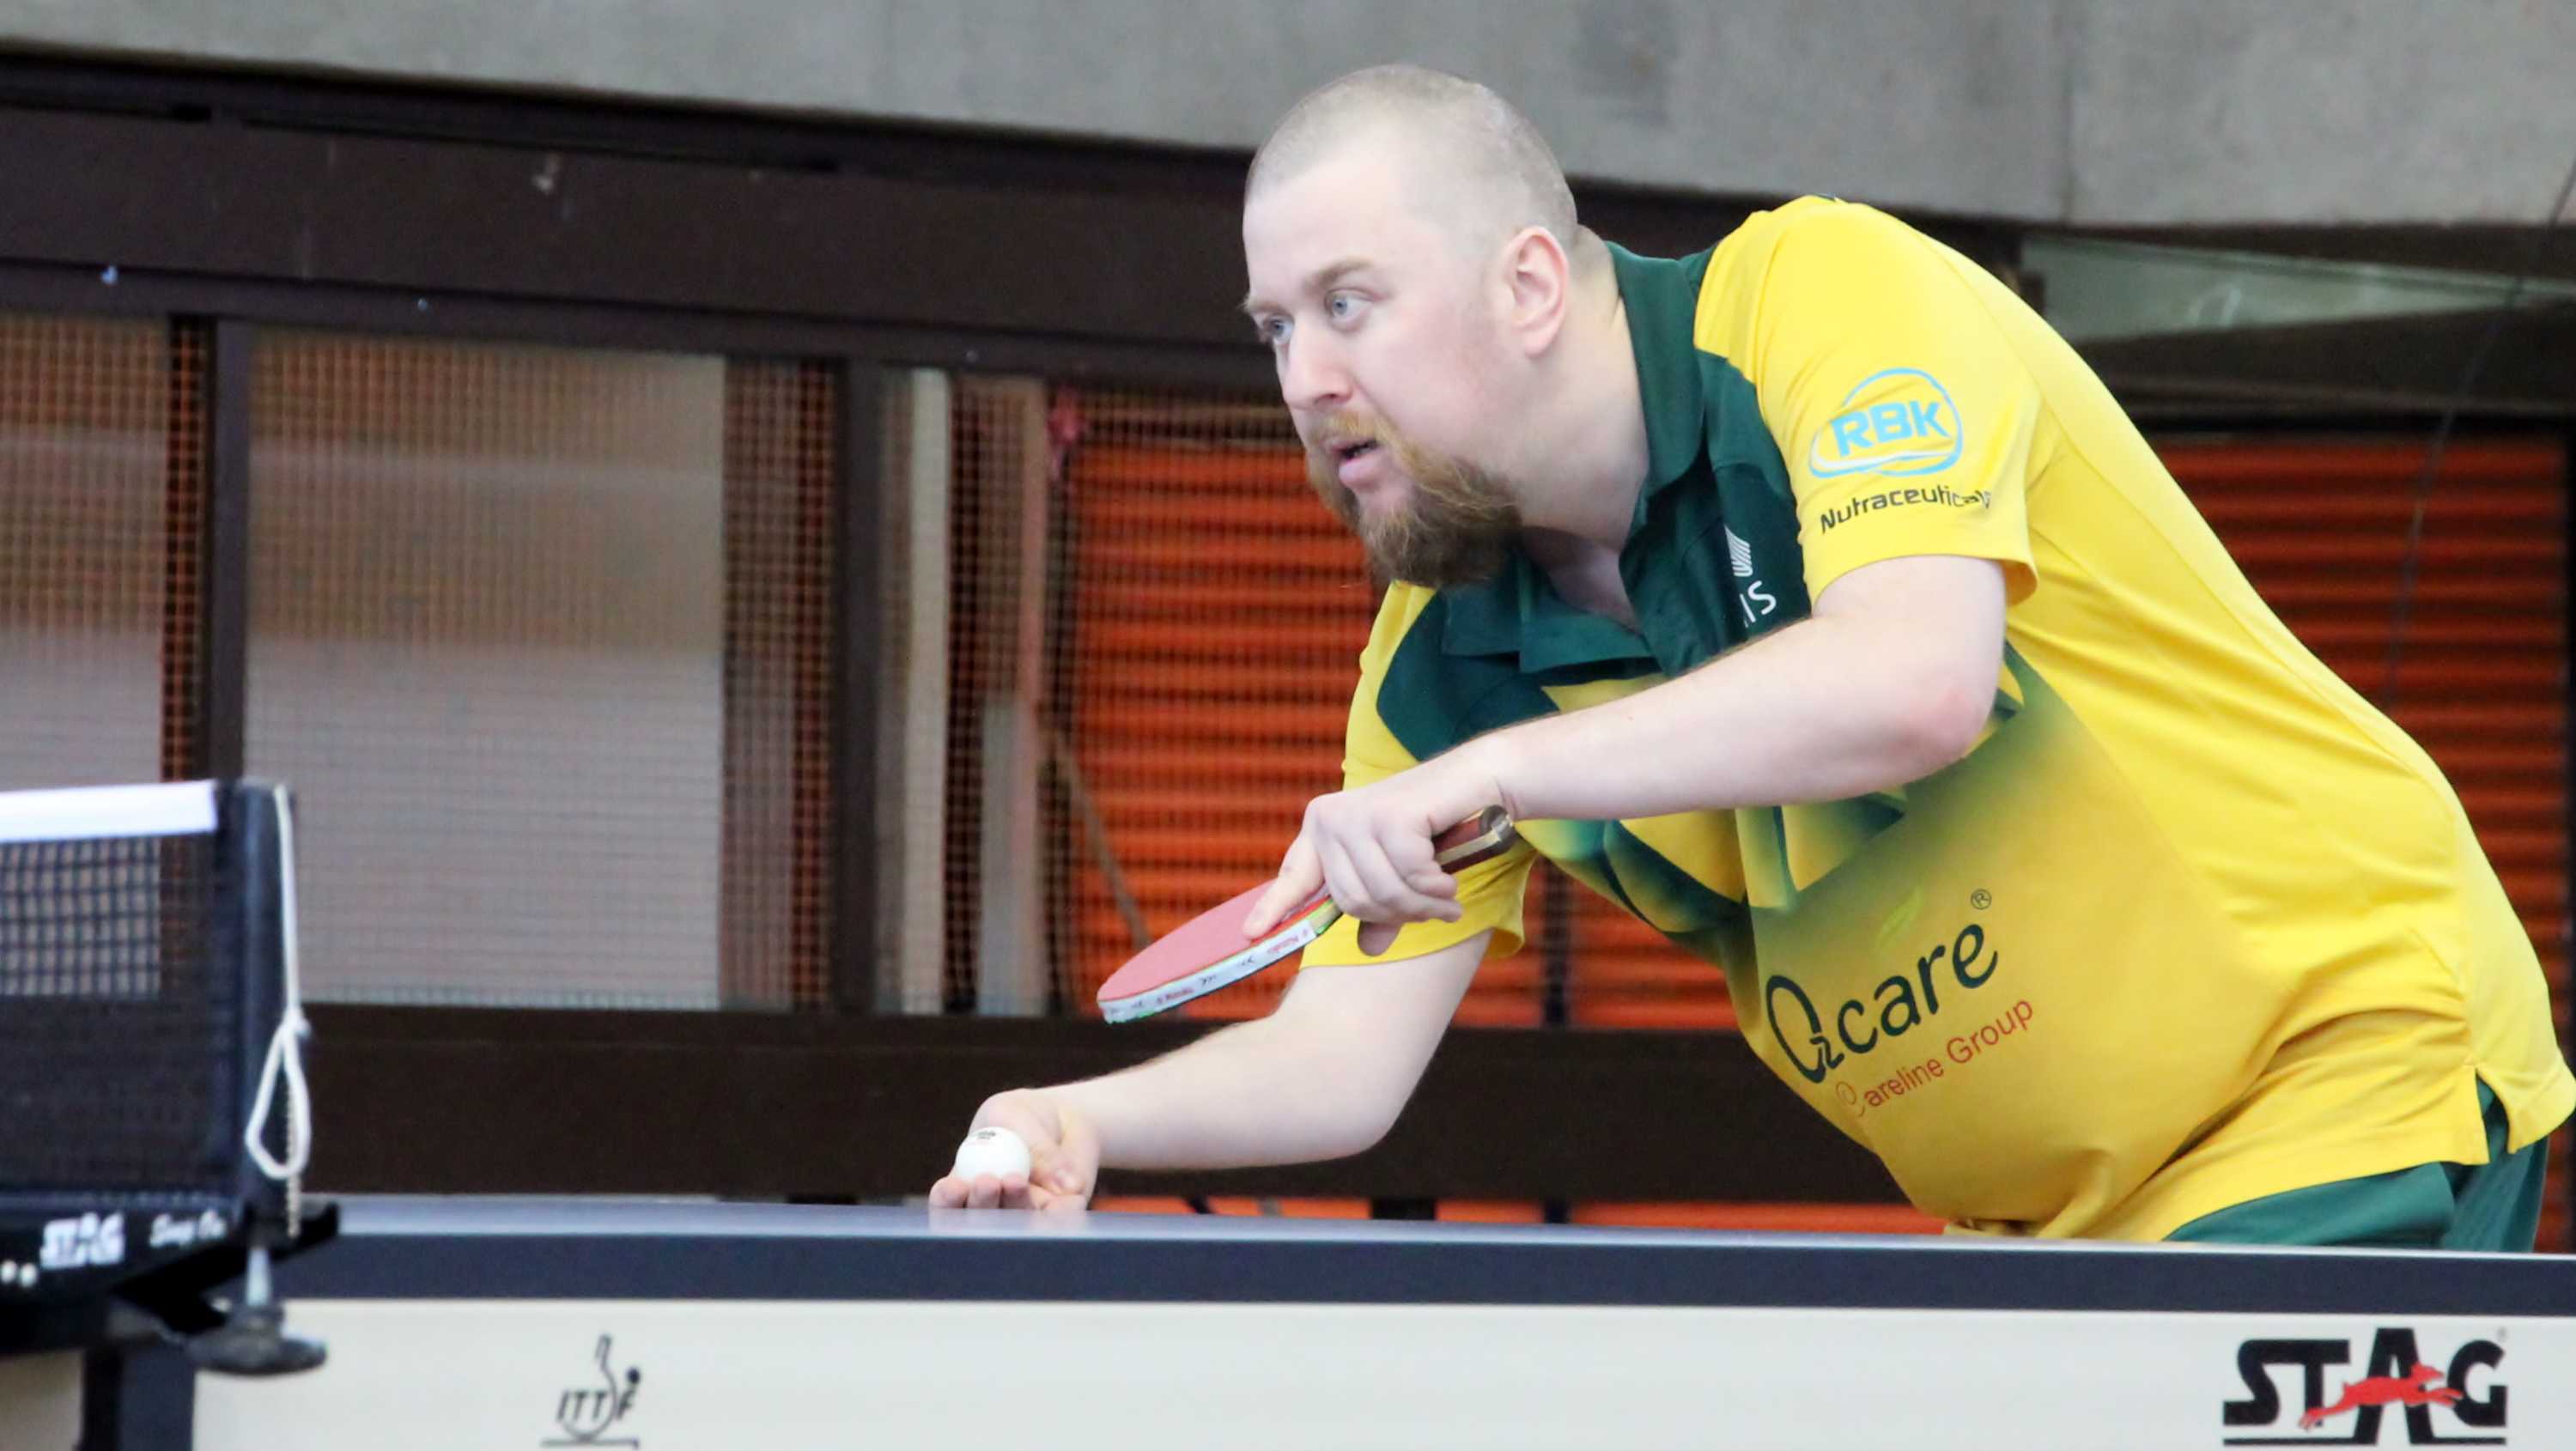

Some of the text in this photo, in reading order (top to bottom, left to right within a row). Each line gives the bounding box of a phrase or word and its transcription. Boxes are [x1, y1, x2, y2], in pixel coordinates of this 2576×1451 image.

[1831, 400, 1952, 457] RBK
[1743, 580, 1777, 628] IS
[1947, 999, 2033, 1064] Group
[556, 1387, 636, 1421] ITTF
[2222, 1327, 2508, 1446] STAG
